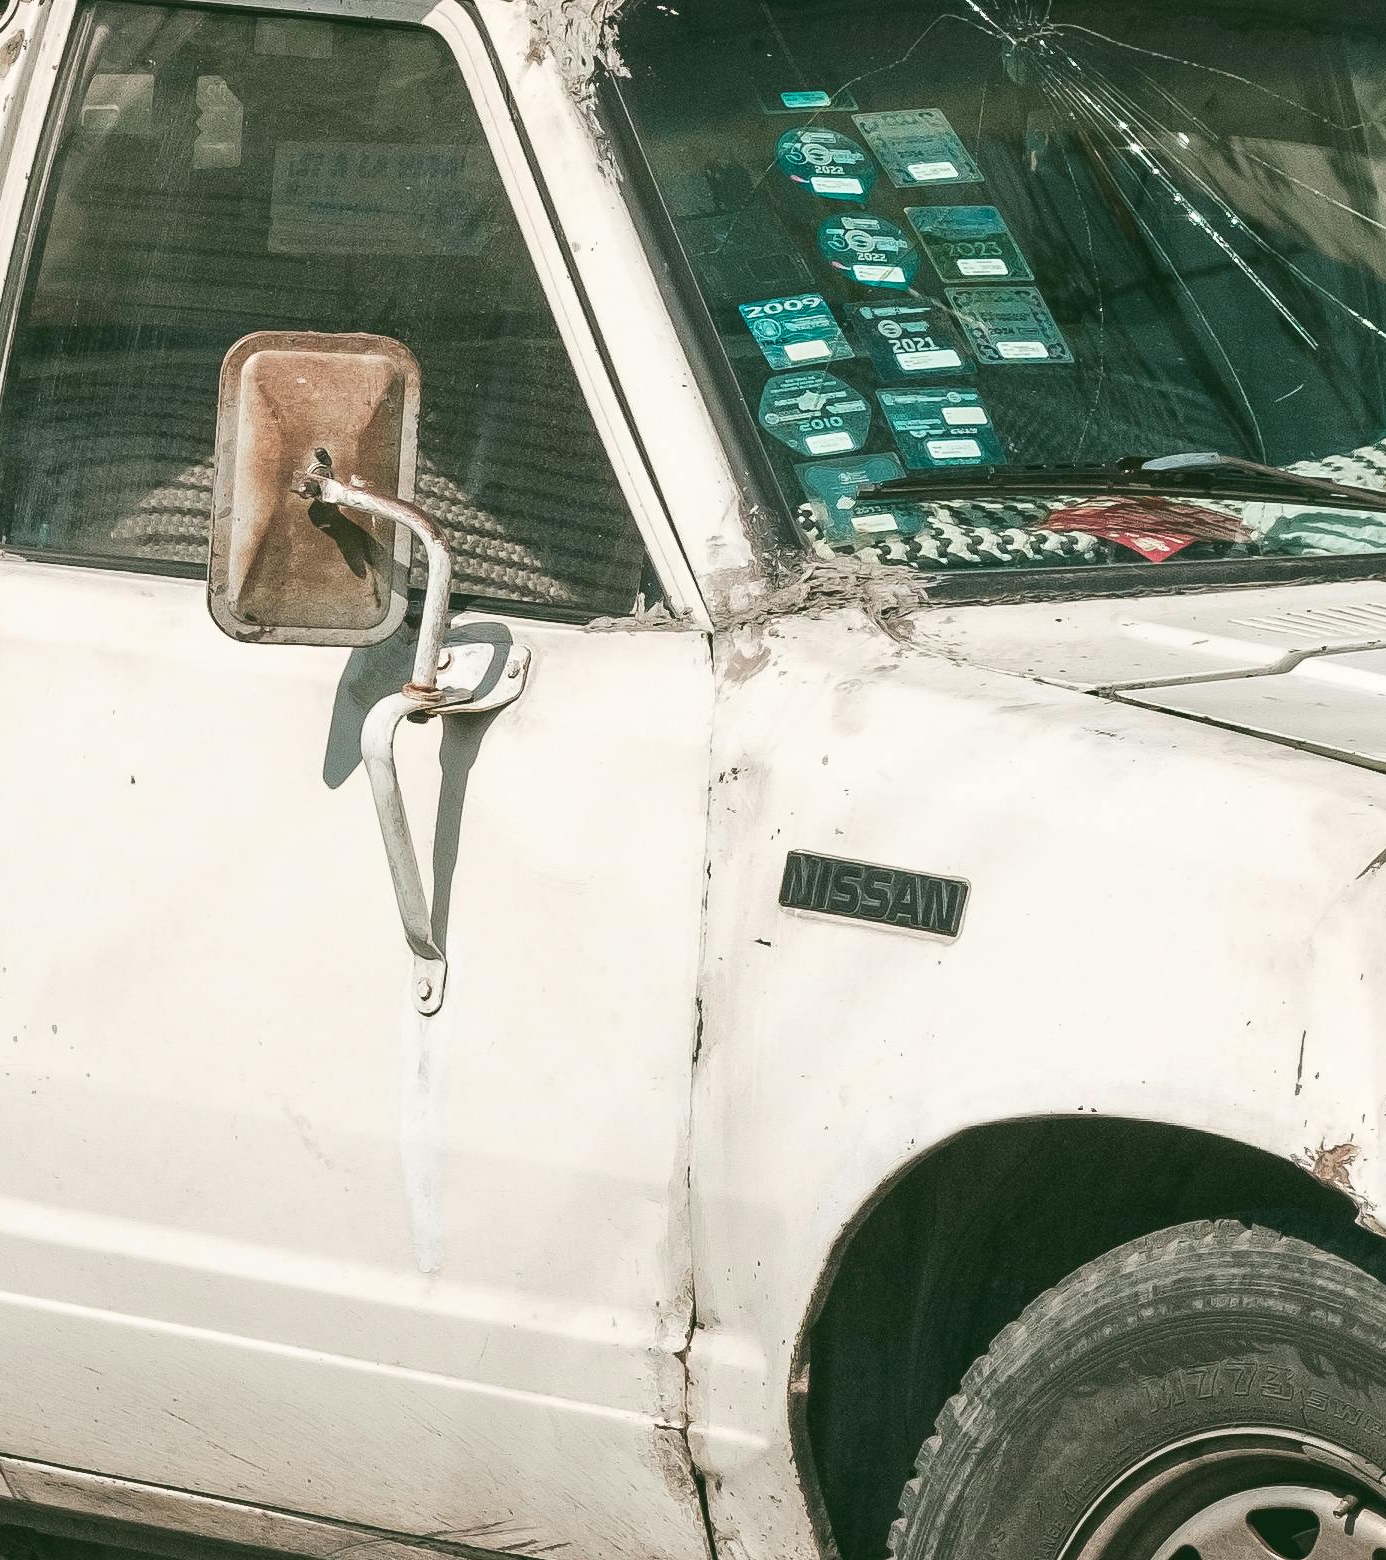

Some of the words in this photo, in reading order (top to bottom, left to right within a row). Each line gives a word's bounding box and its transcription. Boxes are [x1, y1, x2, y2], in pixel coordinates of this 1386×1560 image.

[814, 165, 846, 175] 2022
[856, 252, 888, 262] 2022
[942, 241, 1003, 257] 2023
[744, 297, 822, 319] 2009
[888, 336, 940, 354] 2021
[797, 416, 843, 432] 2010
[786, 853, 960, 933] NISSAN
[1142, 1361, 1296, 1412] M773
